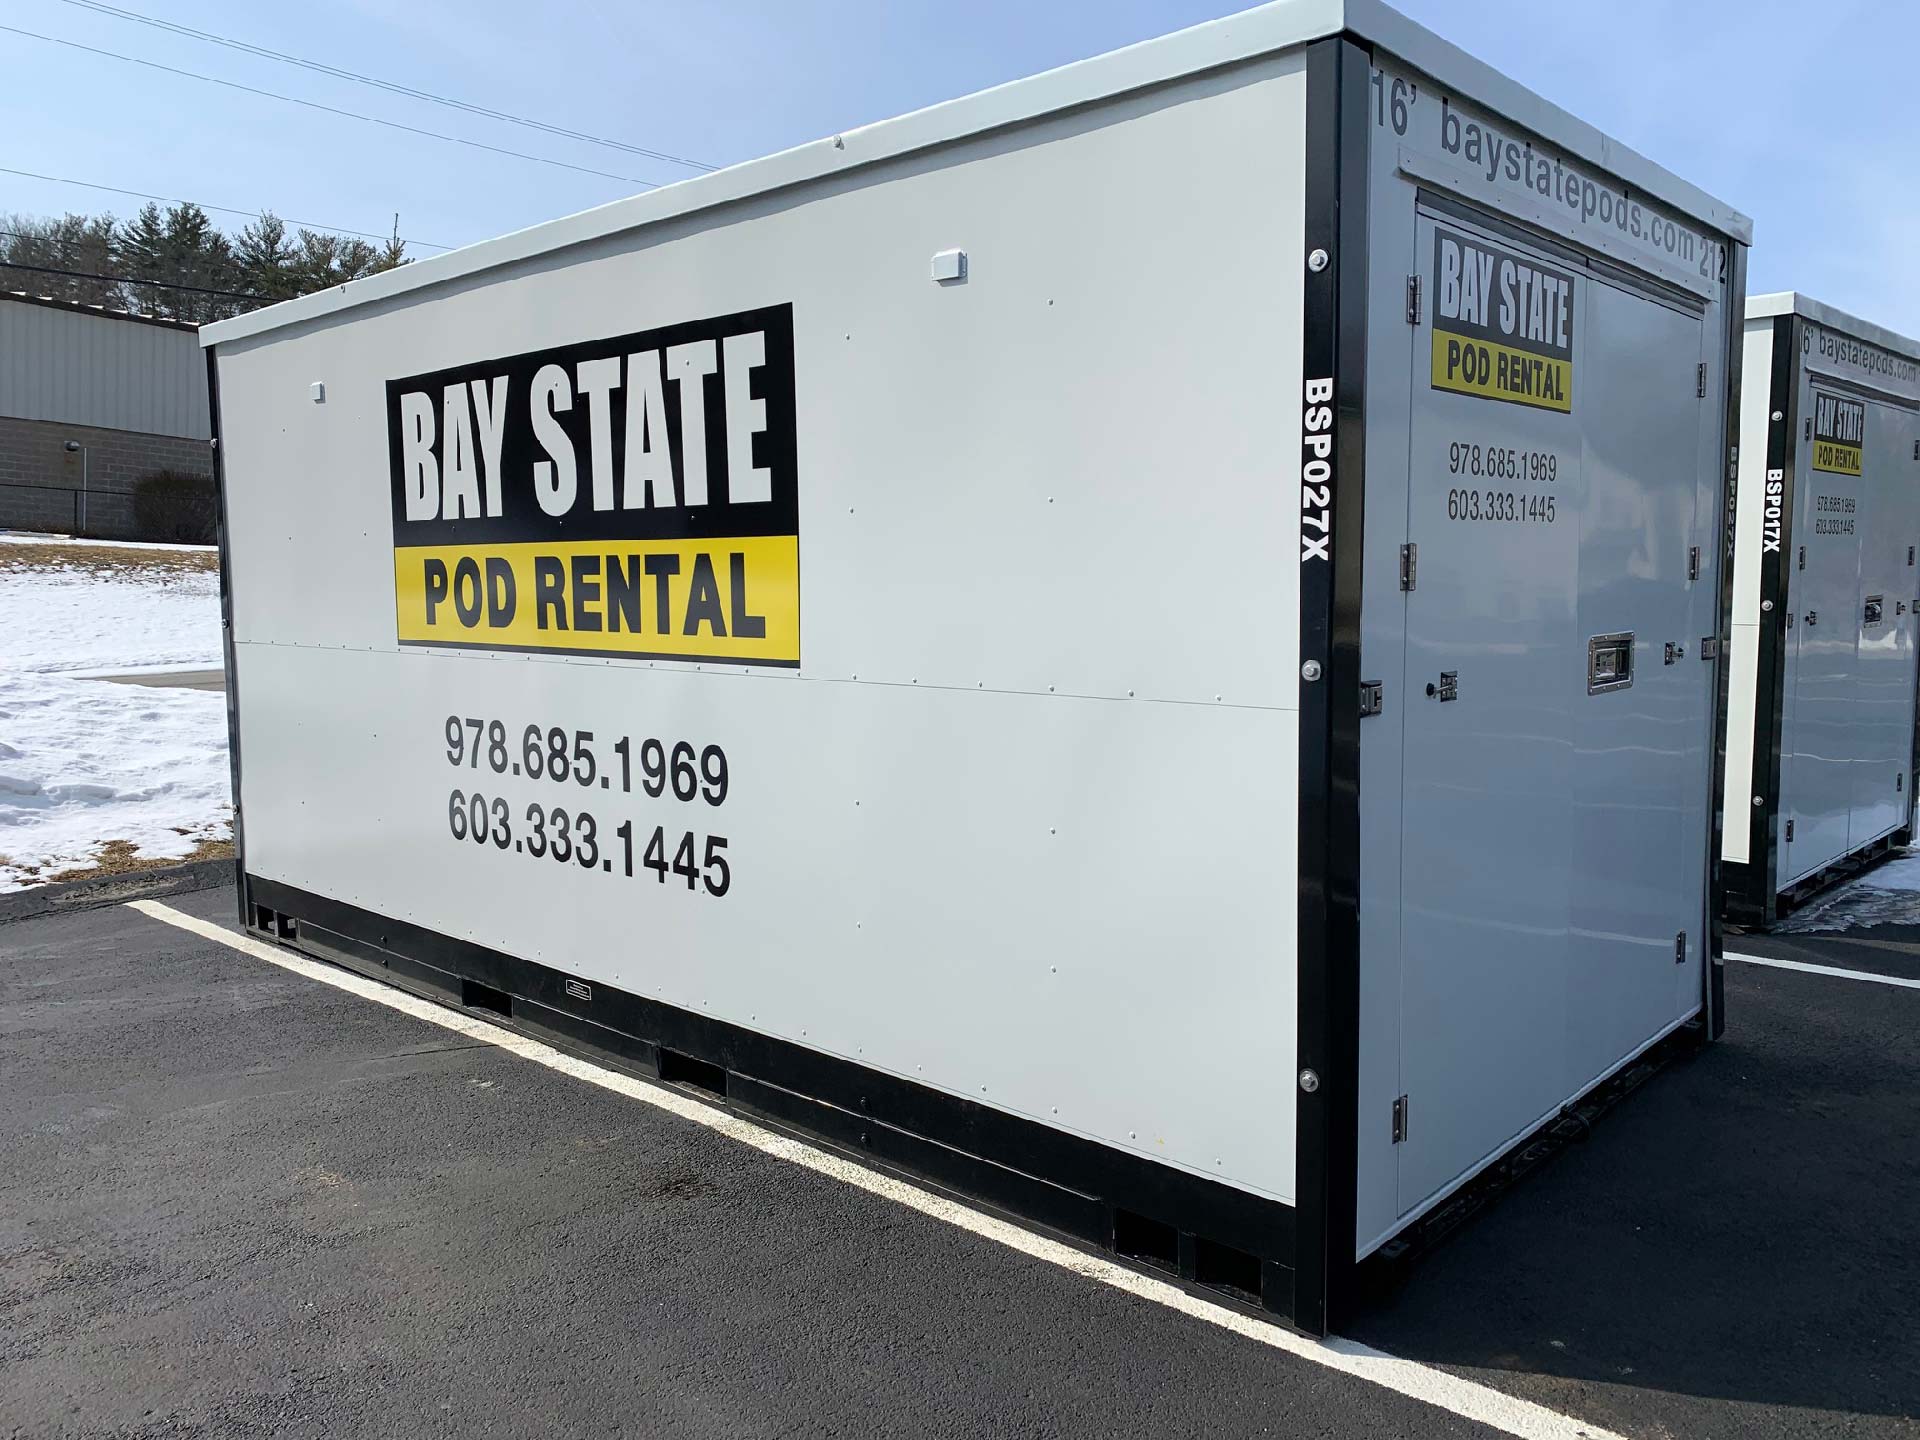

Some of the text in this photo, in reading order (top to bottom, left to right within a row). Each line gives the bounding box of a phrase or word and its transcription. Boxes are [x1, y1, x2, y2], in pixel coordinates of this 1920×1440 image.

[1441, 96, 1695, 262] baystatepods.com
[1440, 238, 1569, 349] BAY STATE
[1447, 339, 1564, 401] POD RENTAL
[400, 330, 772, 522] BAY STATE
[1449, 441, 1557, 482] 978.685.1969
[1817, 396, 1863, 442] BAY STATE
[1818, 444, 1860, 471] POD RENTAL
[1301, 377, 1333, 562] BSP027X
[1448, 488, 1556, 523] 603.333.1445
[1763, 468, 1784, 553] BSP017X
[423, 552, 766, 639] POD RENTAL
[445, 715, 729, 807] 978.685.1969
[449, 789, 731, 897] 603.333.1445
